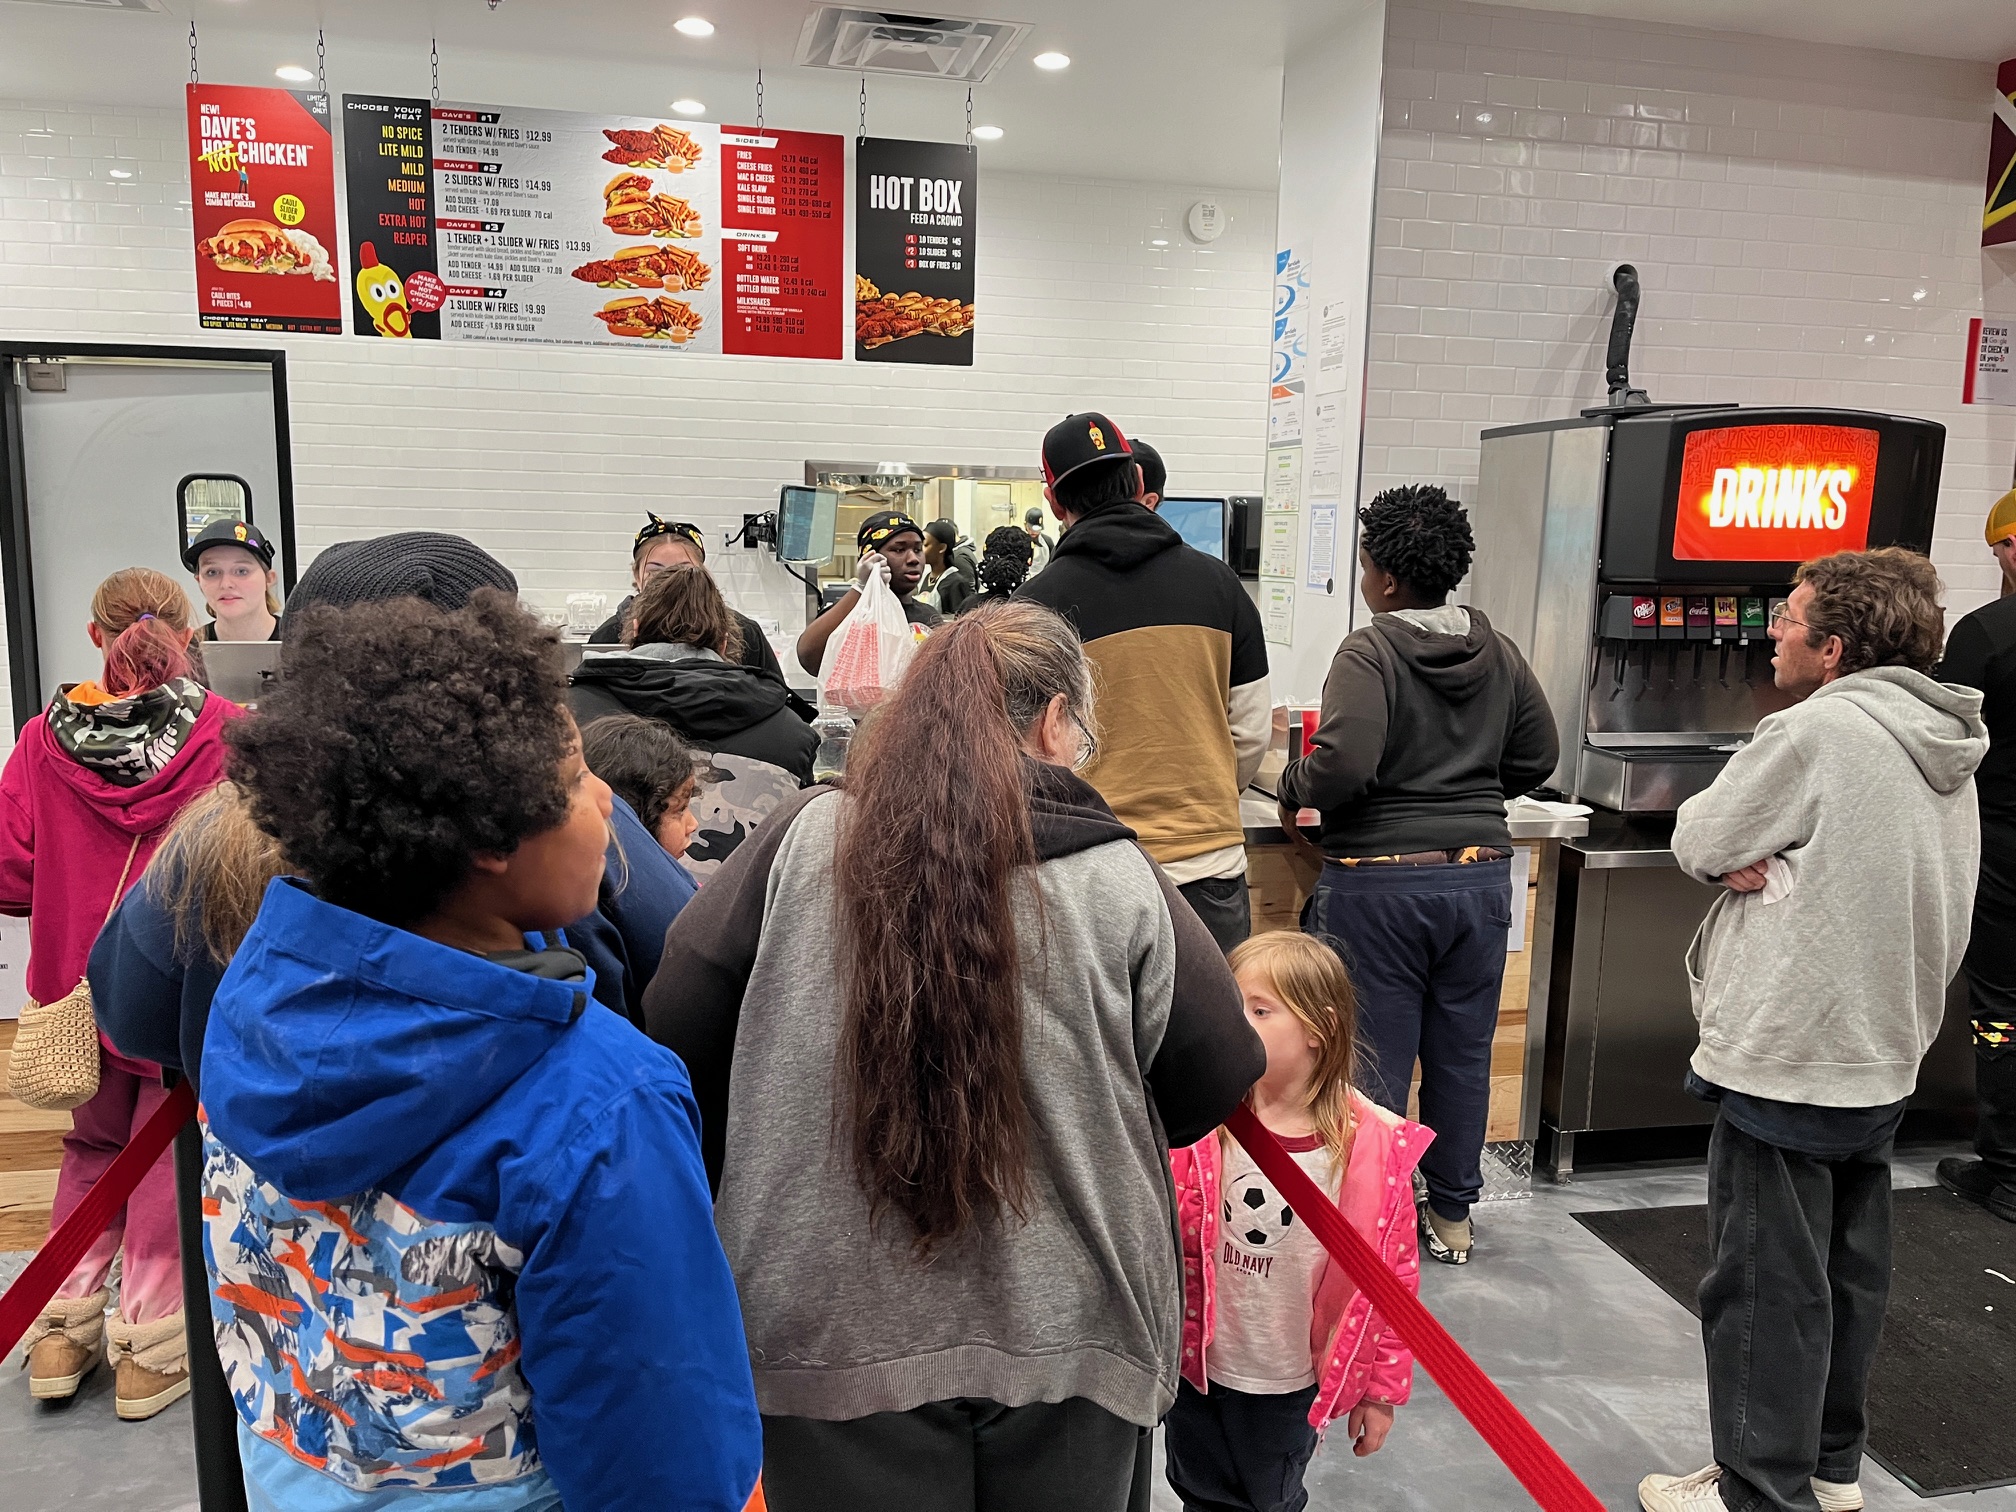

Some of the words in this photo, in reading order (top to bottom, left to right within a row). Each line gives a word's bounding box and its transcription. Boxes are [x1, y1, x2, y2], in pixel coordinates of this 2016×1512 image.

[201, 104, 220, 115] NEW!
[347, 103, 389, 112] CHOOSE
[394, 106, 422, 114] YOUR
[201, 116, 256, 140] DAVE'S
[382, 126, 394, 139] NO
[397, 126, 423, 140] SPICE
[443, 124, 447, 134] 2
[450, 124, 482, 136] TENDERS
[485, 127, 496, 138] W/
[499, 128, 519, 140] FRIES
[526, 131, 552, 142] $12.99
[379, 143, 398, 156] LITE
[401, 145, 424, 158] MILD
[443, 145, 454, 153] ADD
[456, 145, 477, 155] TENDER
[737, 151, 752, 160] FRIES
[208, 152, 239, 173] NOT
[444, 162, 473, 170] DAVE'S
[737, 162, 757, 171] CHEESE
[758, 163, 772, 172] FRIES
[402, 162, 424, 176] MILD
[445, 174, 450, 184] 2
[452, 174, 482, 186] SLIDERS
[485, 177, 495, 187] W/
[499, 178, 519, 189] FRIES
[526, 180, 551, 191] $14.99
[737, 173, 750, 182] MAC
[756, 174, 775, 183] CHEESE
[388, 179, 425, 193] MEDIUM
[737, 183, 750, 192] KALE
[752, 184, 767, 193] SLAW
[205, 191, 219, 199] MAKE
[220, 192, 231, 200] ANY
[737, 194, 755, 203] SINGLE
[757, 195, 774, 205] SLIDER
[870, 175, 914, 210] HOT
[919, 178, 963, 214] BOX
[282, 198, 297, 206] CAULI
[409, 198, 426, 211] HOT
[458, 196, 477, 205] SLIDER
[280, 205, 298, 215] SLIDER
[446, 205, 457, 213] ADD
[458, 205, 479, 214] CHEESE
[512, 209, 531, 218] SLIDER
[535, 211, 542, 219] 70
[544, 211, 552, 219] cal
[738, 205, 755, 214] SINGLE
[757, 206, 776, 215] TENDER
[379, 213, 407, 227] EXTRA
[410, 216, 426, 228] HOT
[911, 213, 928, 224] FEED
[930, 214, 935, 225] A
[936, 215, 963, 226] CROWD
[394, 232, 427, 246] REAPER
[447, 233, 452, 242] 1
[454, 233, 482, 245] TENDER
[491, 236, 496, 245] 1
[498, 236, 523, 247] SLIDER
[525, 238, 537, 248] W/
[540, 239, 559, 250] FRIES
[566, 241, 590, 251] $13.99
[919, 235, 926, 243] 10
[927, 236, 948, 245] TENDERS
[738, 244, 750, 252] SOFT
[919, 247, 926, 256] 10
[927, 248, 947, 256] SLIDERS
[448, 260, 459, 268] ADD
[461, 261, 481, 269] TENDER
[510, 264, 520, 272] ADD
[522, 265, 540, 273] SLIDER
[919, 260, 929, 268] BOX
[930, 260, 936, 269] OF
[937, 261, 950, 270] FRIES
[418, 275, 437, 283] MAKE
[461, 271, 482, 279] CHEESE
[515, 274, 533, 282] SLIDER
[737, 274, 759, 283] BOTTLED
[760, 276, 779, 284] WATER
[409, 278, 423, 286] ANY
[425, 282, 443, 291] MEAL
[418, 286, 432, 294] NOT
[737, 284, 759, 293] BOTTLED
[410, 290, 439, 301] CHICKEN
[217, 300, 233, 308] PIECES
[450, 300, 455, 309] 1
[458, 300, 482, 311] SLIDER
[485, 302, 495, 311] W/
[499, 303, 518, 313] FRIES
[525, 304, 545, 314] $9.99
[737, 297, 770, 306] MILKSHAKES
[451, 320, 462, 328] ADD
[463, 321, 483, 329] CHEESE
[505, 323, 514, 331] PER
[517, 324, 535, 332] SLIDER
[1983, 327, 2000, 336] REVIEW
[2001, 328, 2007, 336] US
[1988, 345, 2009, 354] CHECK-IN
[1709, 468, 1851, 530] DRINKS
[1224, 1242, 1240, 1265] OLD
[1242, 1255, 1273, 1278] NAVY
